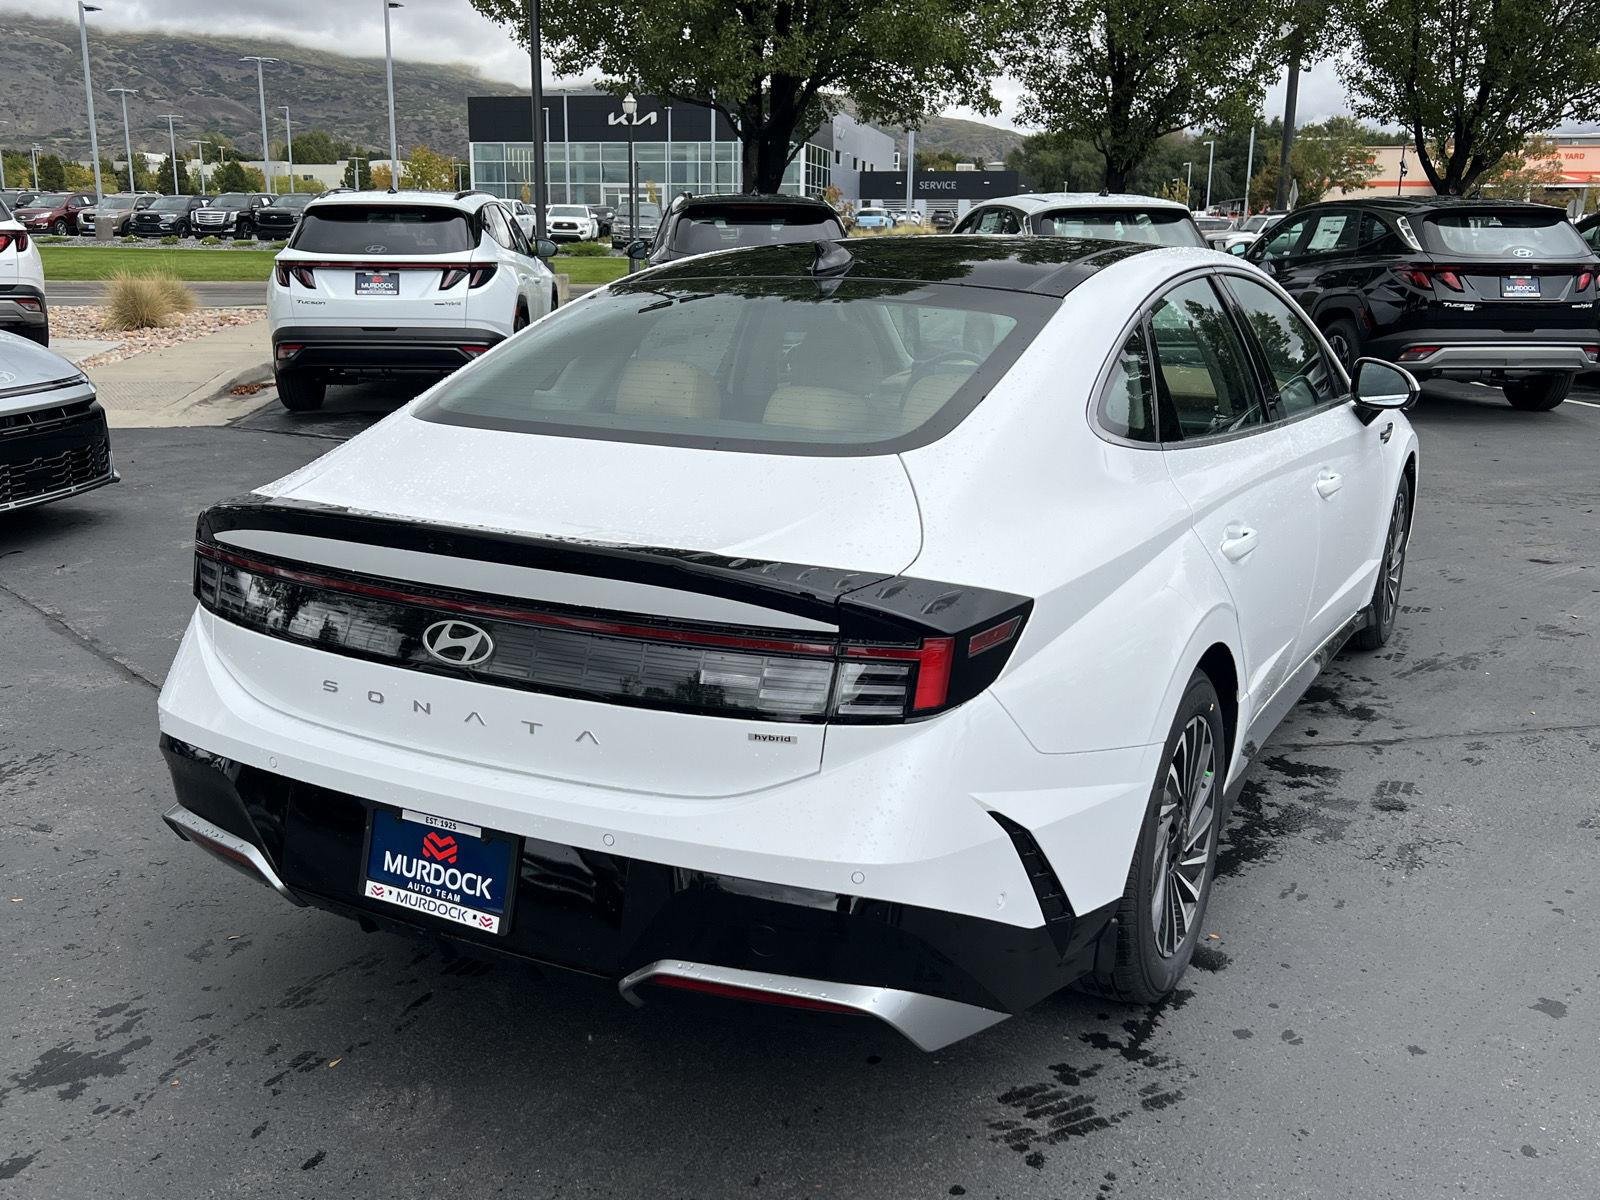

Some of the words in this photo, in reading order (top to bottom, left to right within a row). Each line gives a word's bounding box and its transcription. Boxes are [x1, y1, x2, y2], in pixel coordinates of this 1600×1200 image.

[608, 111, 657, 126] KIA
[1564, 152, 1585, 160] YARD
[919, 181, 957, 190] SERVICE
[322, 680, 600, 745] SONATA
[754, 733, 791, 743] hybrid
[425, 816, 440, 827] EST.
[440, 818, 457, 830] 1925
[383, 850, 493, 900] MURDOCK
[407, 881, 432, 895] AUTO
[435, 888, 461, 903] TEAM
[396, 891, 468, 922] MURDOCK
